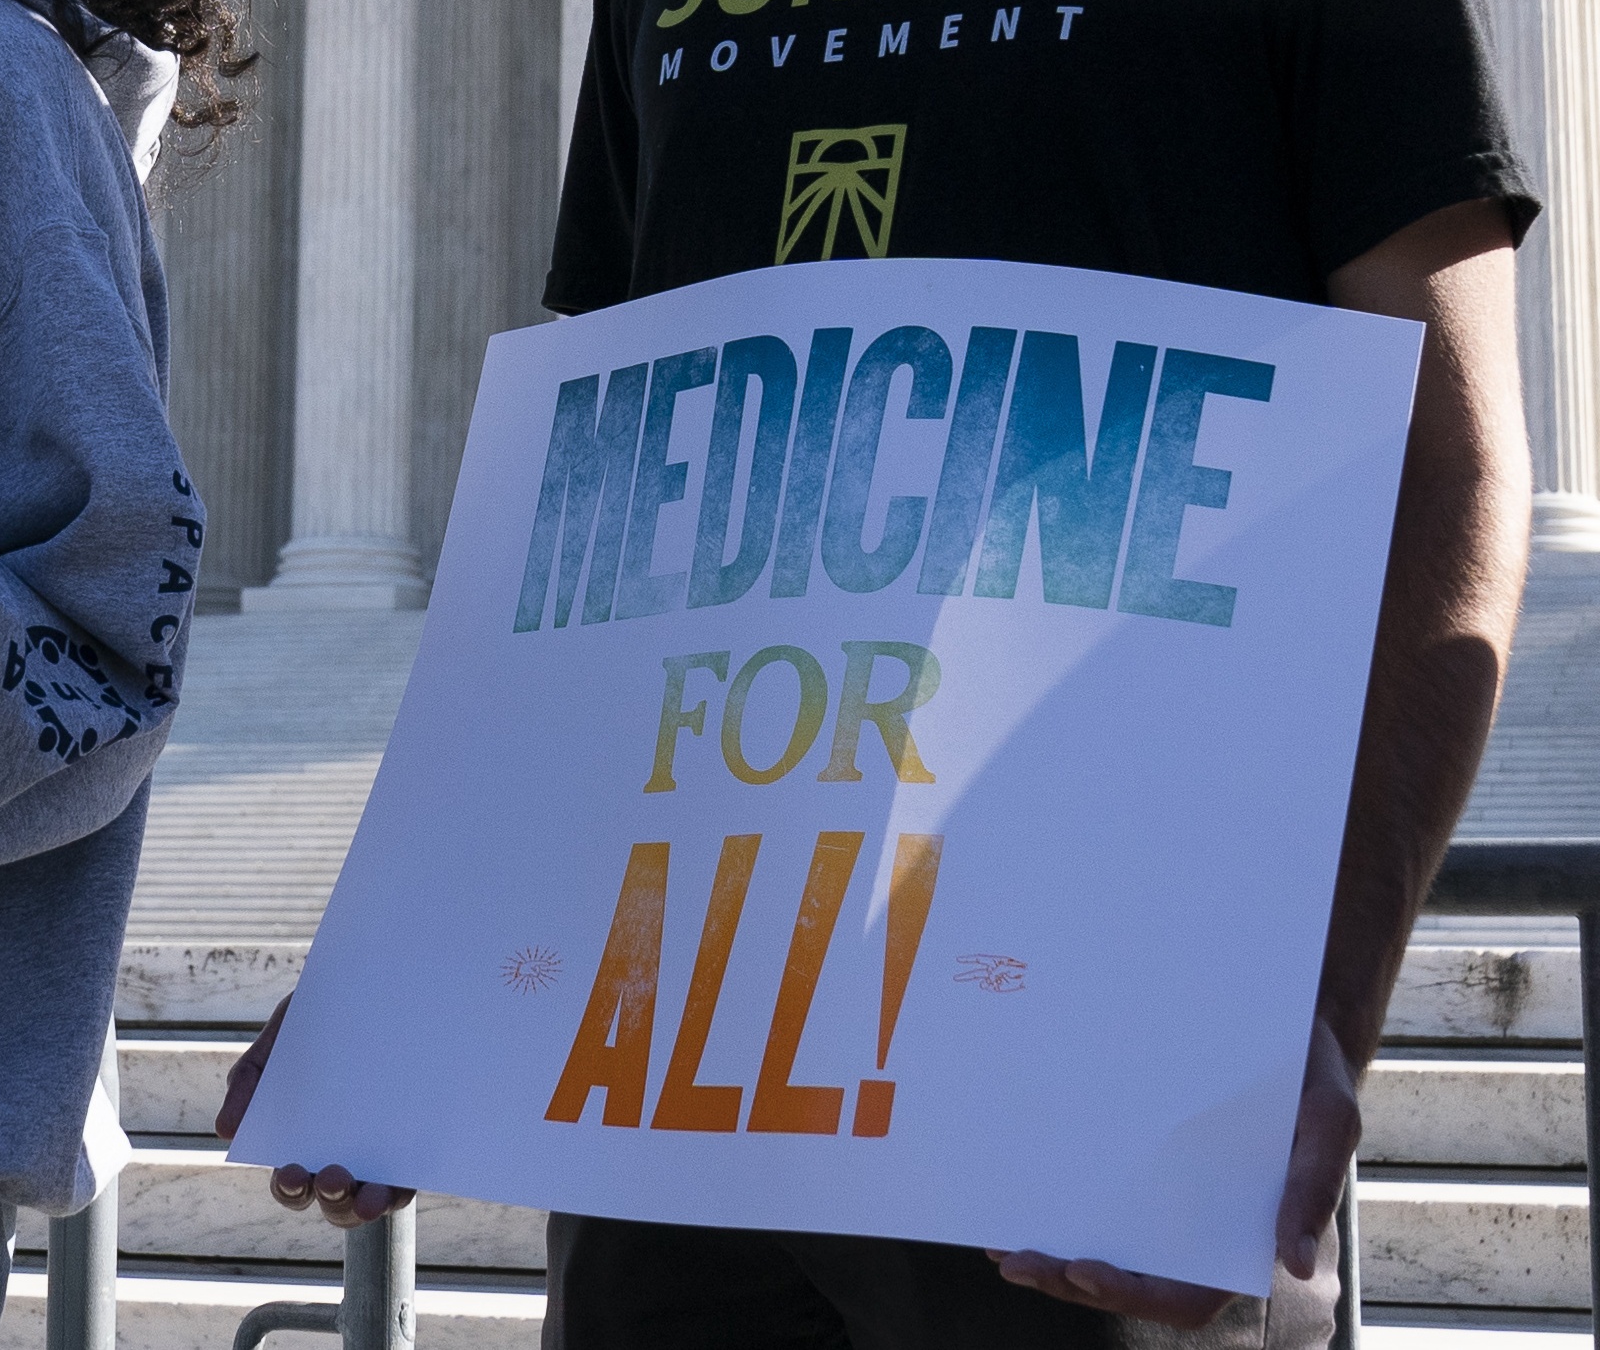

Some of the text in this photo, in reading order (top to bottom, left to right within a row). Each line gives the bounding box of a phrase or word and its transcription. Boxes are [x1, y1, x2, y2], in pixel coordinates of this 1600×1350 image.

[659, 6, 1084, 85] MOVEMENT
[511, 324, 1276, 633] MEDICINE
[642, 641, 942, 793] FOR
[544, 831, 944, 1137] ALL!
